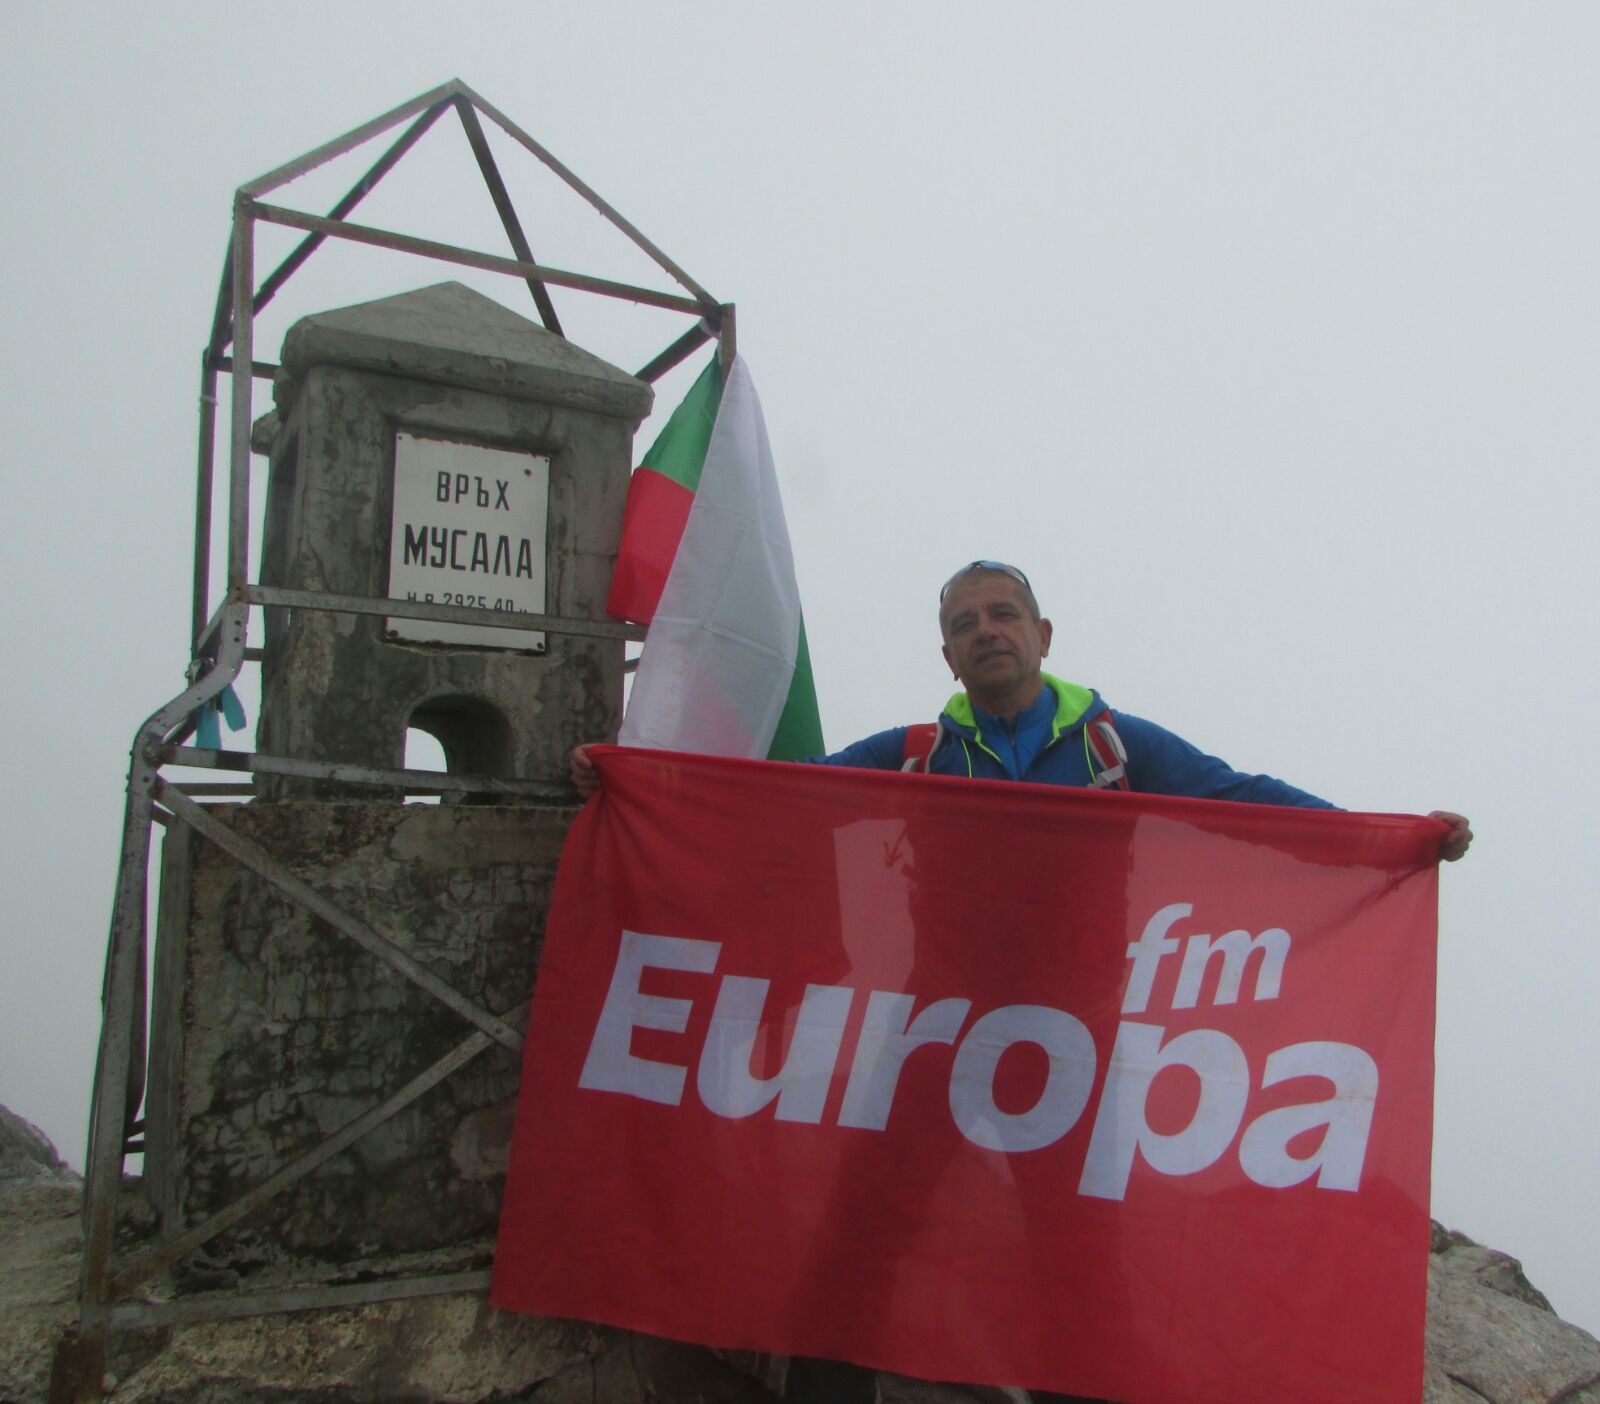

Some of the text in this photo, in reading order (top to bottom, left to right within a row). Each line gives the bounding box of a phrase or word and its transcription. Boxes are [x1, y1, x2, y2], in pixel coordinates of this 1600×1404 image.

[436, 471, 510, 511] ВРЪХ
[404, 524, 533, 579] МУСАЛА
[1120, 903, 1292, 1014] fm
[578, 930, 1379, 1200] Europa
